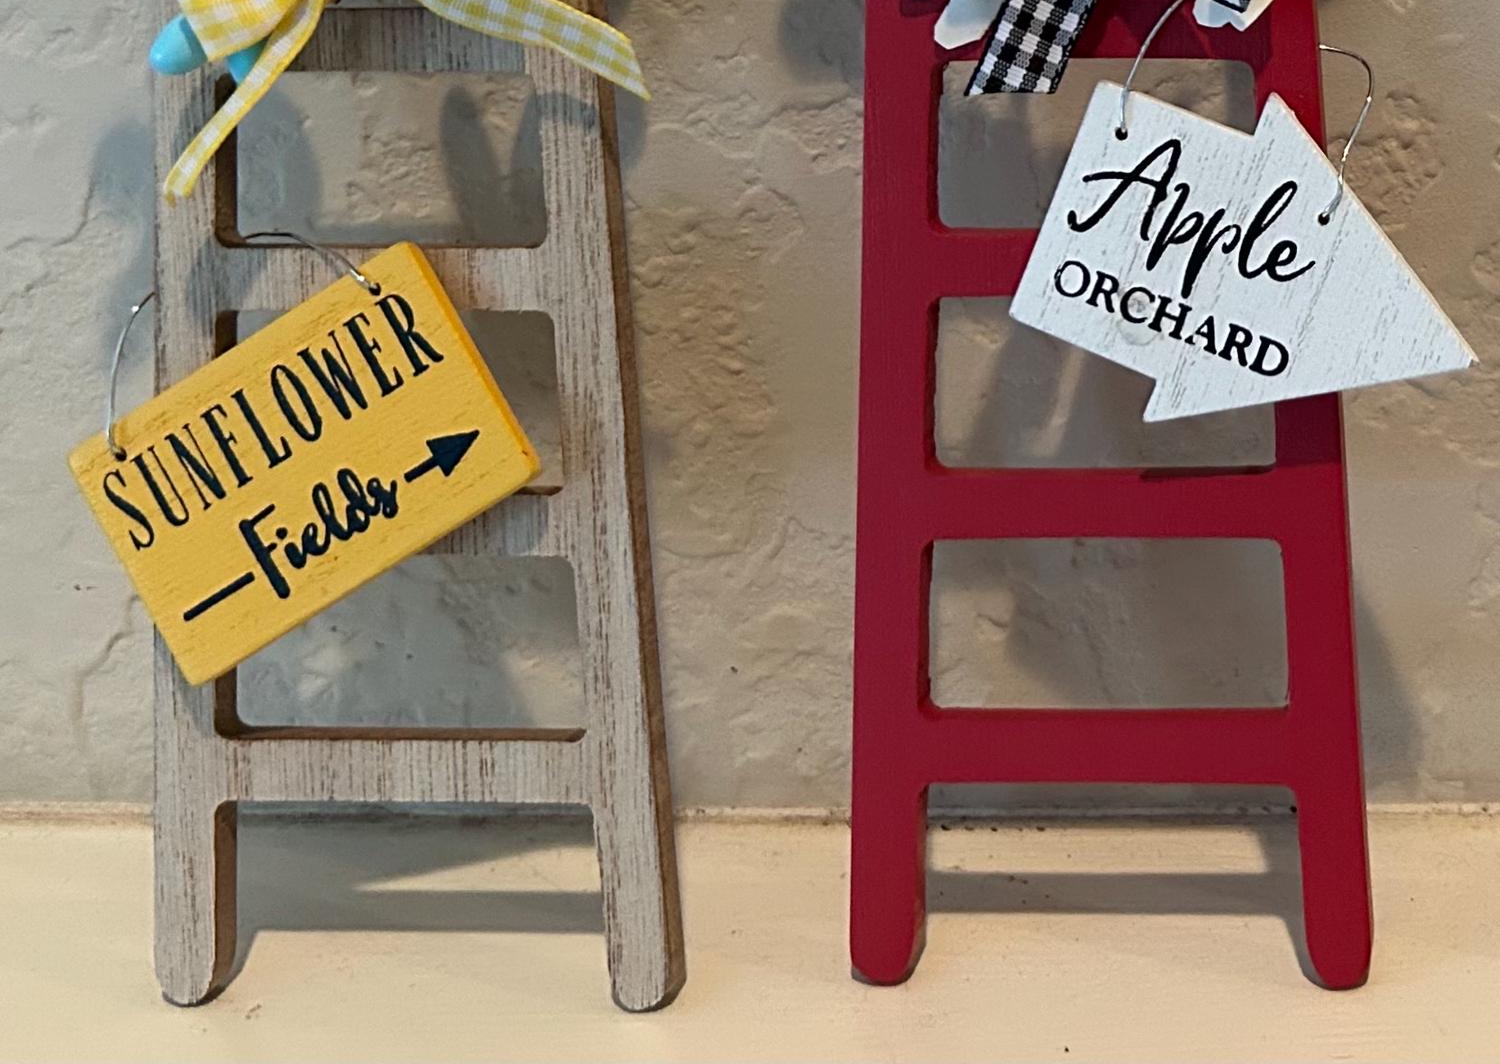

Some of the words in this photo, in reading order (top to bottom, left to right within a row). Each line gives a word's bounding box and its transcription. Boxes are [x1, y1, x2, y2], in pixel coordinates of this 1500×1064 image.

[1067, 138, 1316, 298] Apple
[1053, 260, 1290, 377] ORCHARD
[102, 292, 444, 552] SUNFLOWER
[239, 467, 399, 600] Fields
